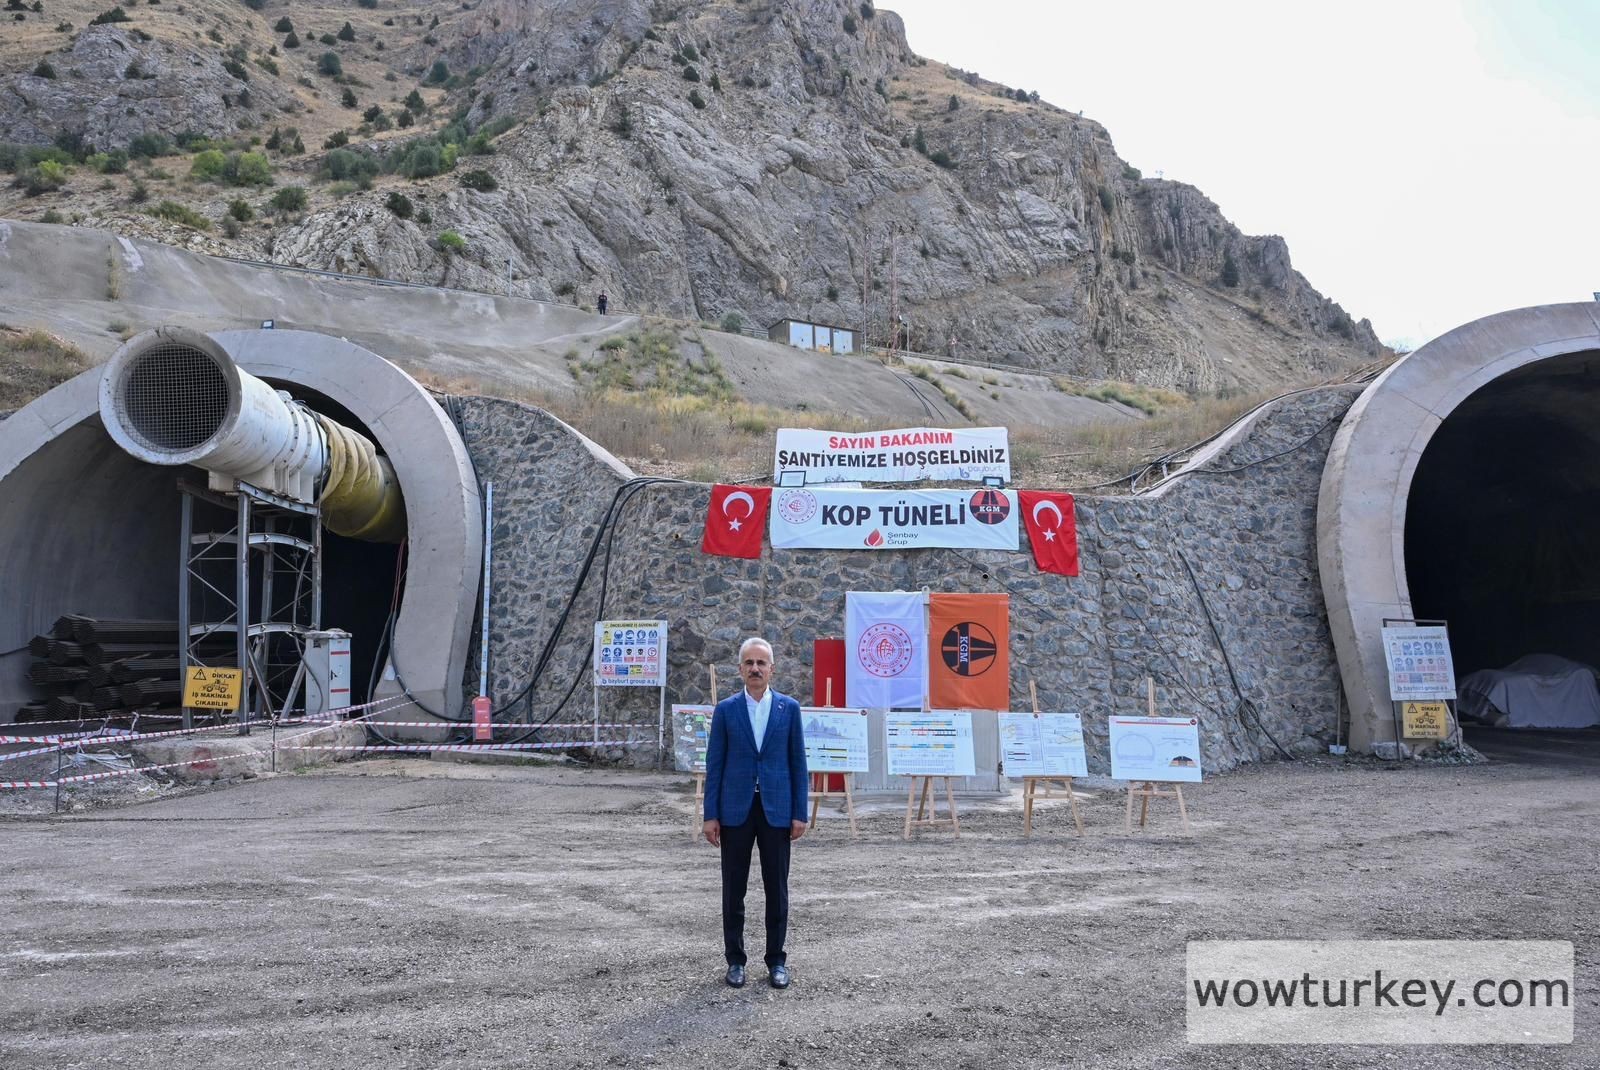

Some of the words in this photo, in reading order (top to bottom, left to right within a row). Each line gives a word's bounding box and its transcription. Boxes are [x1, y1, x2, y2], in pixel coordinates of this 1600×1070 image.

[829, 436, 874, 449] SAYIN
[880, 432, 953, 447] BAKANIM
[778, 450, 887, 470] ŞANTİYEMİZE
[892, 445, 1006, 470] HOŞGELDİNİZ
[821, 505, 872, 525] KOP
[878, 499, 966, 526] TÜNELİ
[887, 531, 919, 540] Şenbay
[960, 636, 968, 663] KGM
